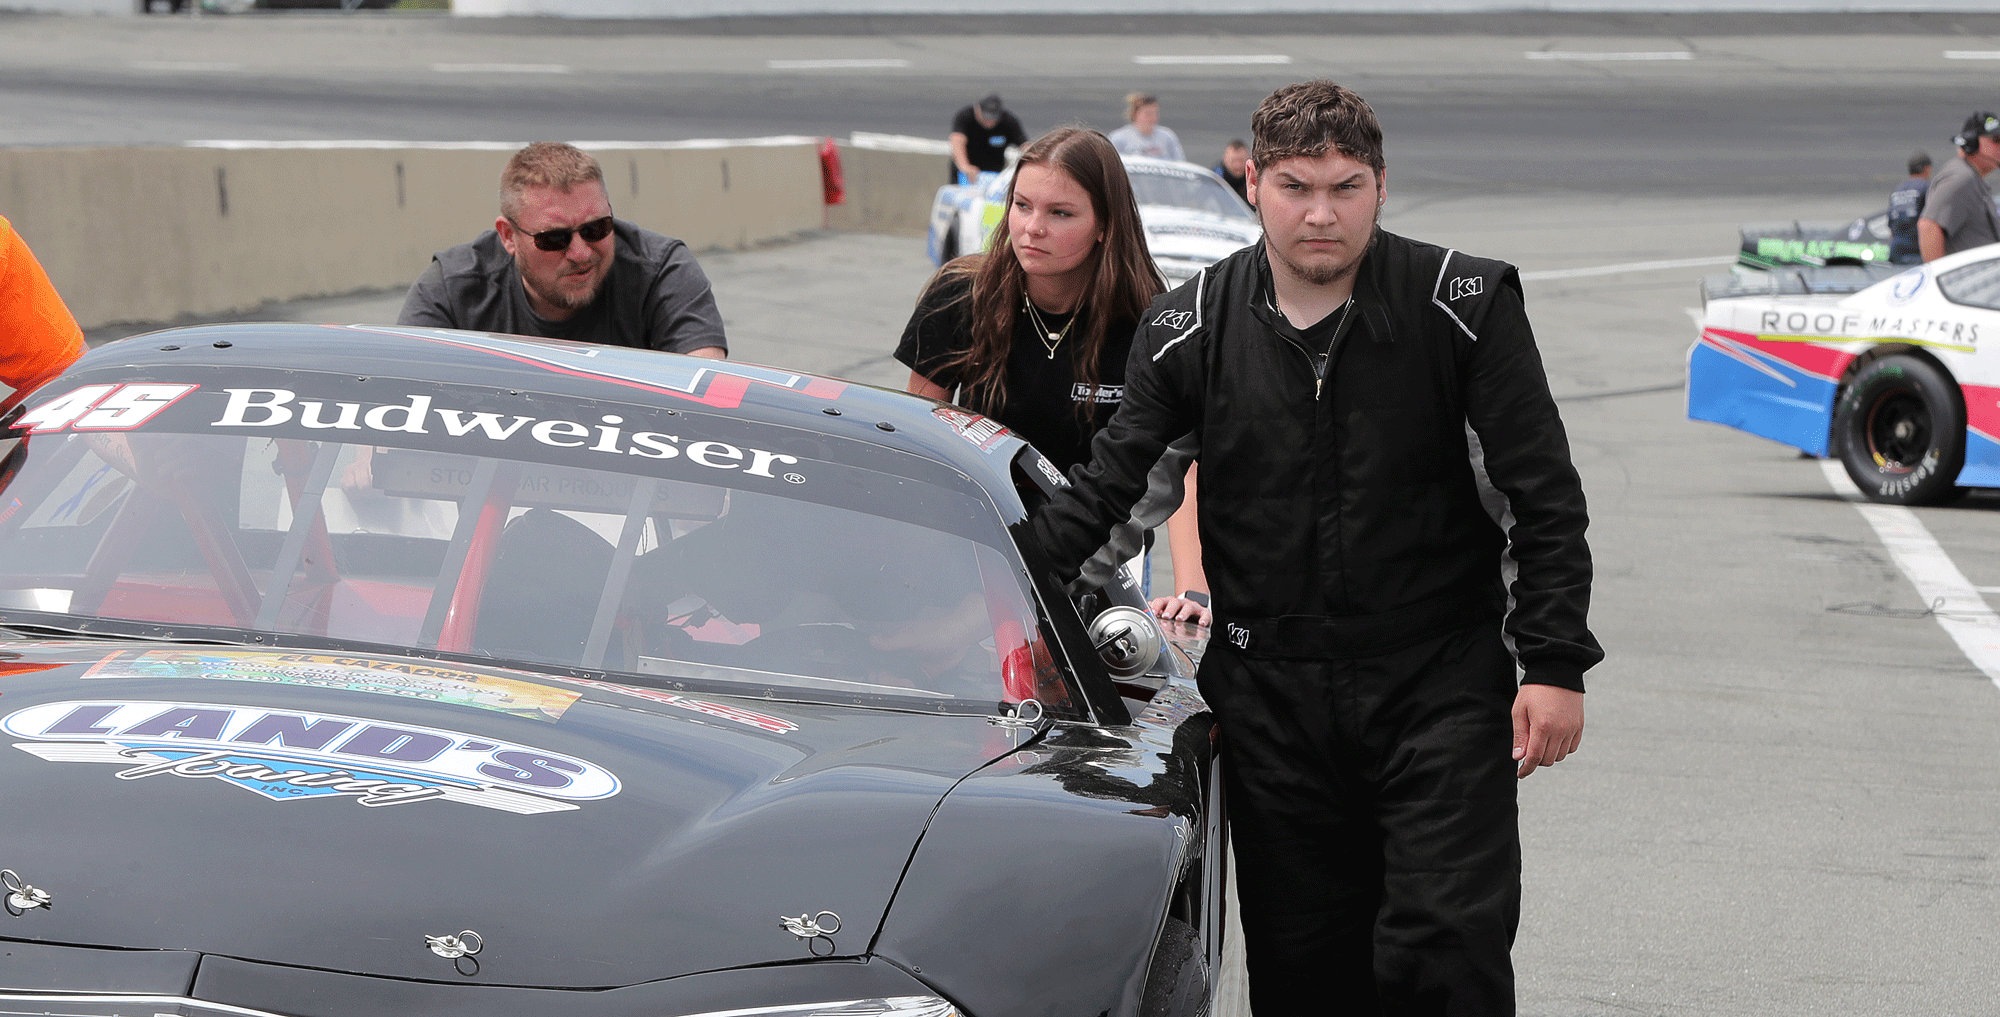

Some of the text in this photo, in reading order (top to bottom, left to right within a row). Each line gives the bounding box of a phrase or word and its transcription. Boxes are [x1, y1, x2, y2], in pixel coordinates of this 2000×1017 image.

[1450, 276, 1484, 301] K1
[1151, 309, 1193, 330] K1
[1761, 311, 1979, 343] ROOF MASTERS
[8, 383, 201, 434] 45
[211, 388, 798, 479] Budweiser
[517, 475, 550, 493] AR
[558, 477, 670, 502] PRODUS
[1227, 622, 1249, 649] K1
[333, 658, 479, 682] CAZADOR
[41, 703, 588, 788] LAND'S
[115, 747, 446, 808] Towing
[260, 785, 309, 797] INC.
